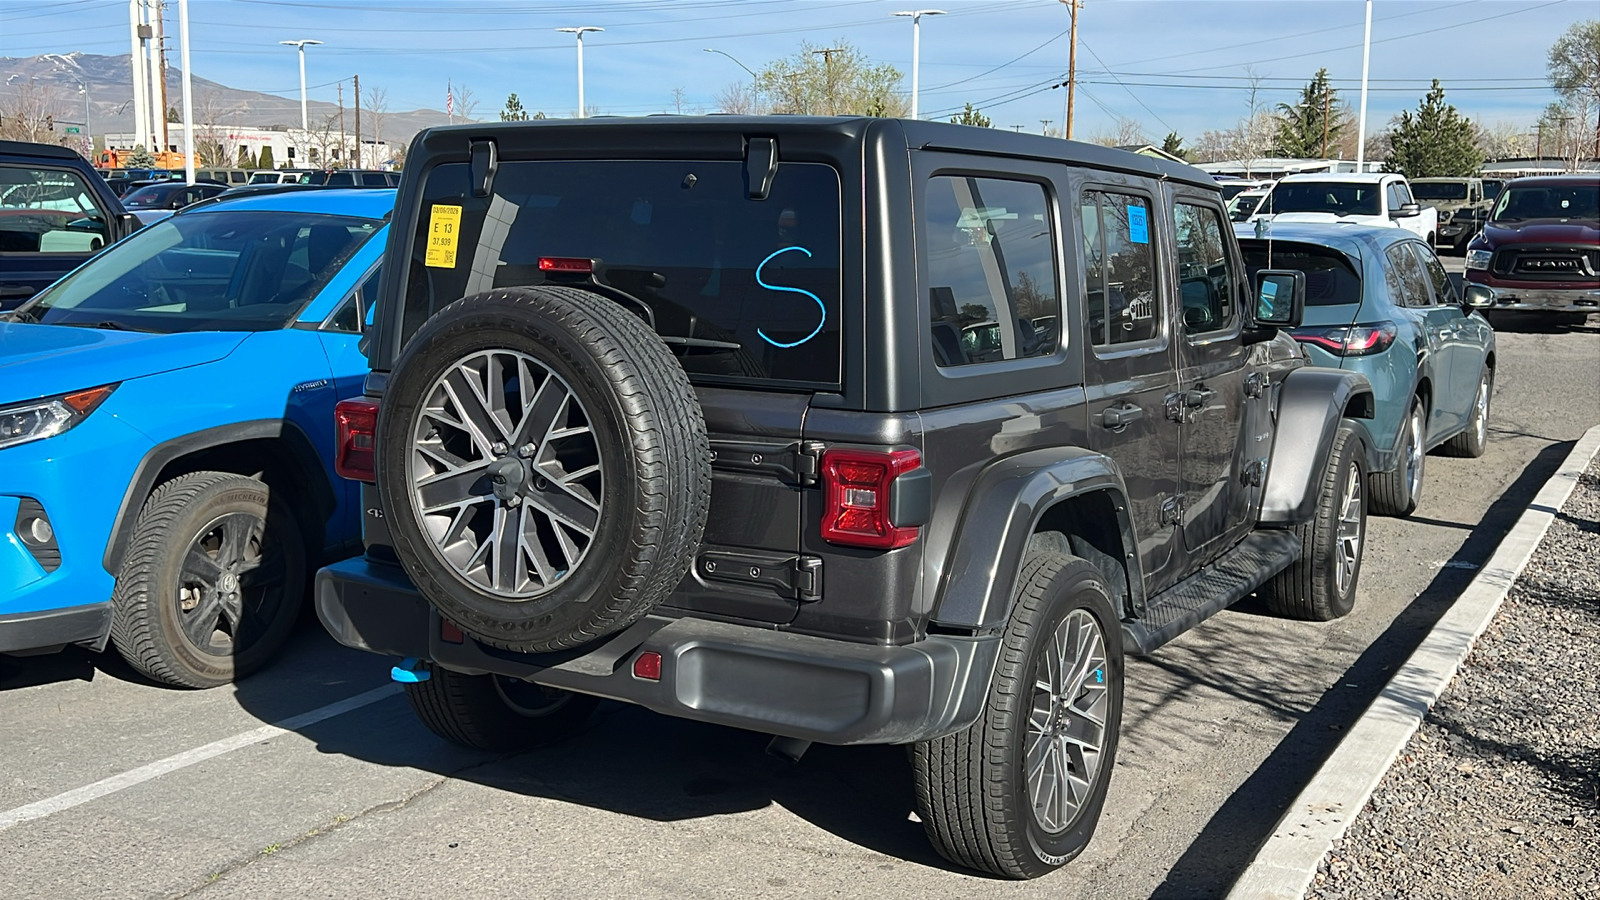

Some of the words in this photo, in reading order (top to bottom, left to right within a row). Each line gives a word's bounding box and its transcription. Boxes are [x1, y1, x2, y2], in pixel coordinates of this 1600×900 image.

[434, 223, 439, 232] E
[444, 223, 453, 234] 13
[756, 246, 826, 348] S
[227, 493, 266, 504] MICHELIN
